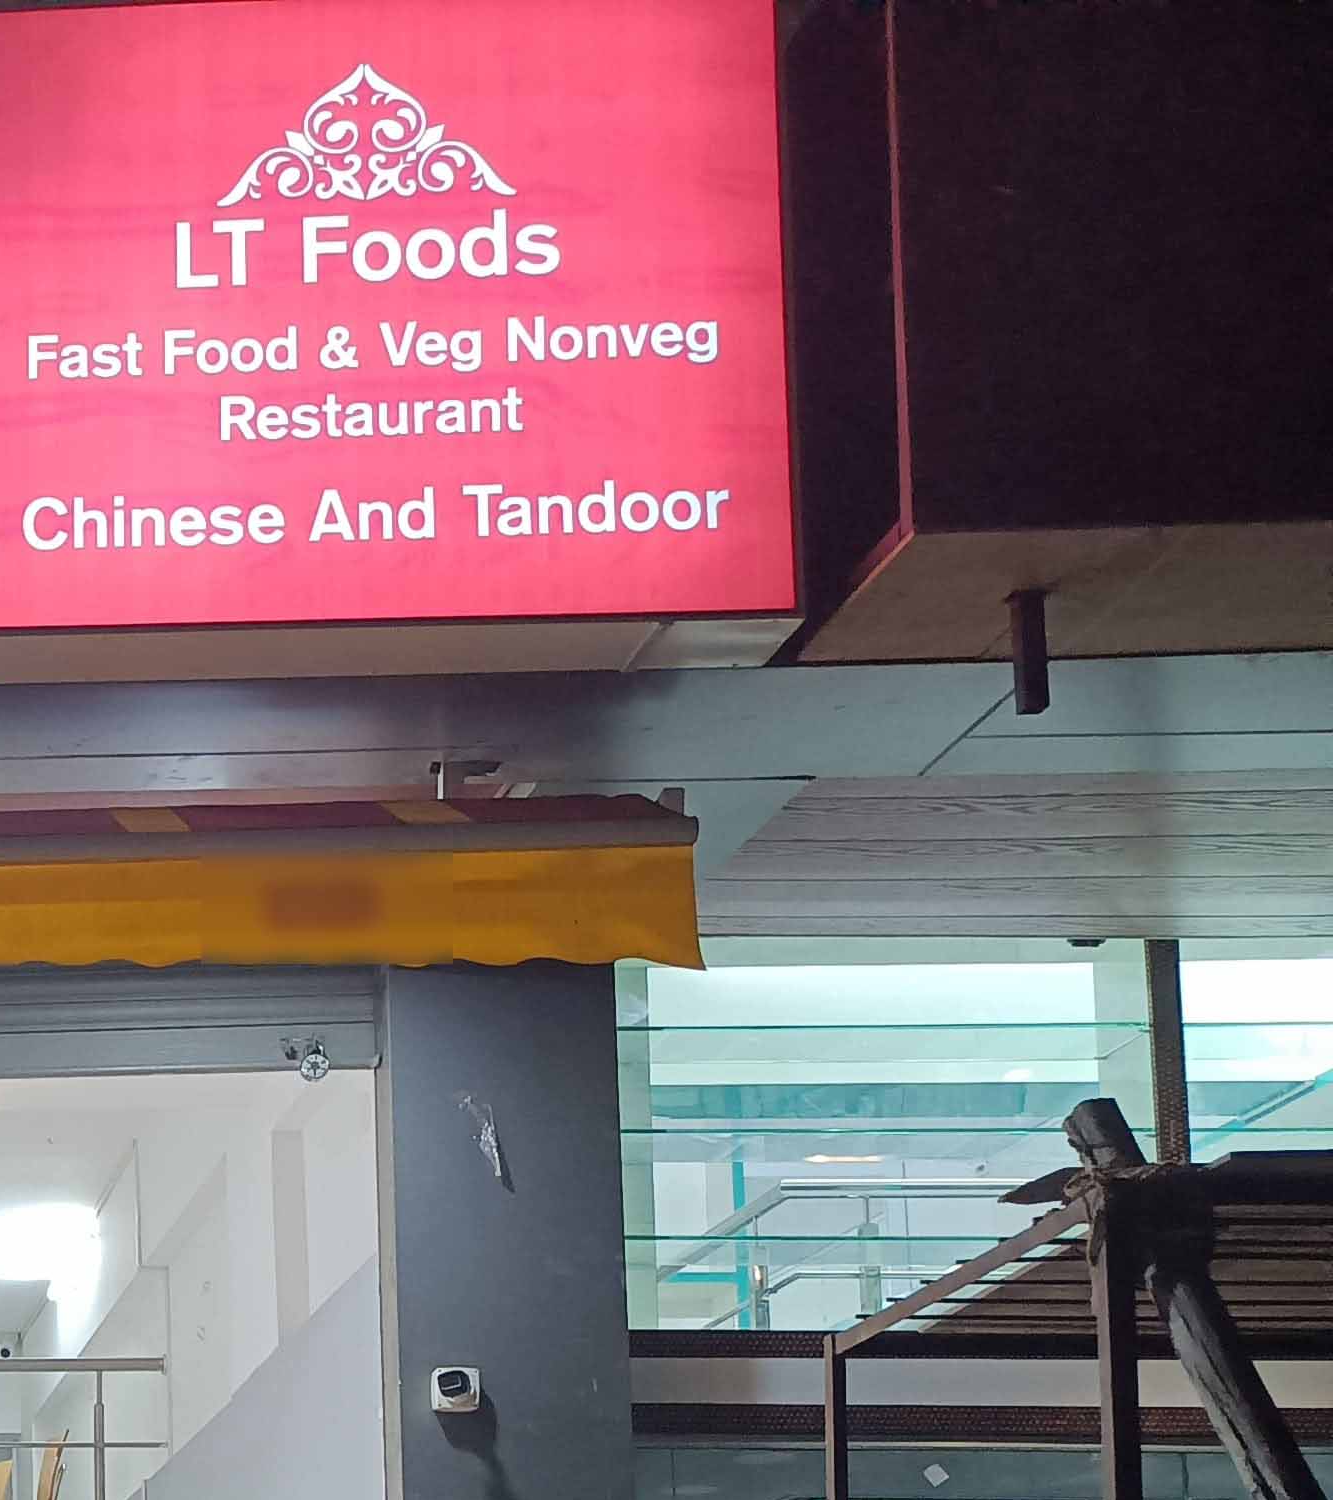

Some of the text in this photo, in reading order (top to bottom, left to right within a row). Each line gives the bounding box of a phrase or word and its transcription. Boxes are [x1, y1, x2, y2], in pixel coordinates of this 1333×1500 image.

[174, 207, 562, 290] LT Foods
[27, 314, 719, 381] Fast Food & Veg Nonveg
[219, 385, 525, 442] Restaurant
[21, 478, 730, 552] Chinese And Tandoor
